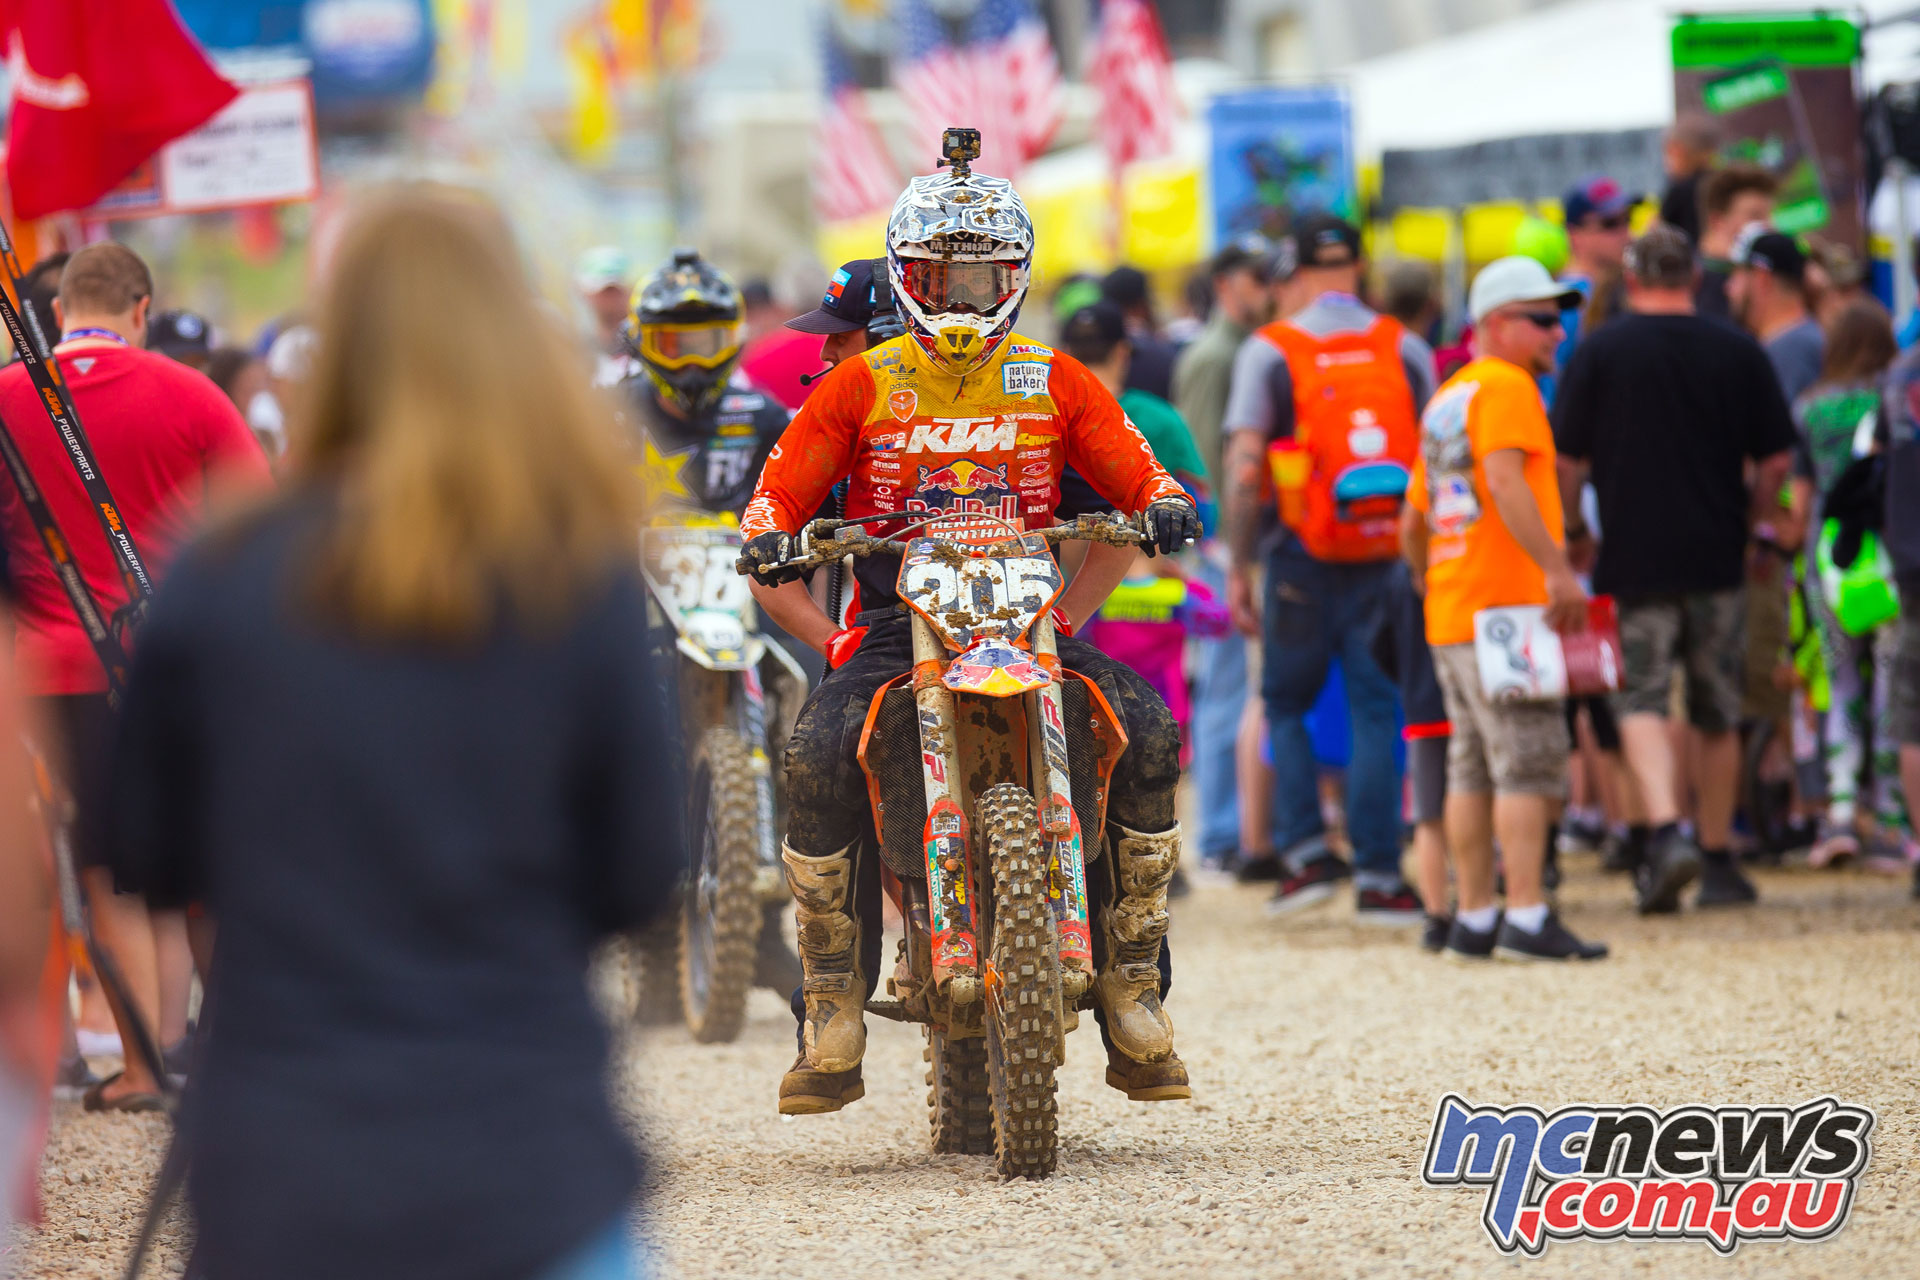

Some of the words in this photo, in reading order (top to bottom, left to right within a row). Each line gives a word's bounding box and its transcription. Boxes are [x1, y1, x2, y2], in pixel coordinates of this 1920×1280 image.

[889, 381, 919, 390] adidas
[1009, 375, 1046, 391] bakery
[42, 387, 63, 416] KTM
[57, 416, 95, 481] POWERPARTS
[867, 432, 906, 445] oPro
[905, 416, 1018, 453] KTM
[100, 503, 122, 532] KTM
[906, 497, 963, 524] Red
[964, 495, 1018, 522] Bull
[906, 558, 1055, 634] 205
[929, 870, 941, 918] MOTOREX
